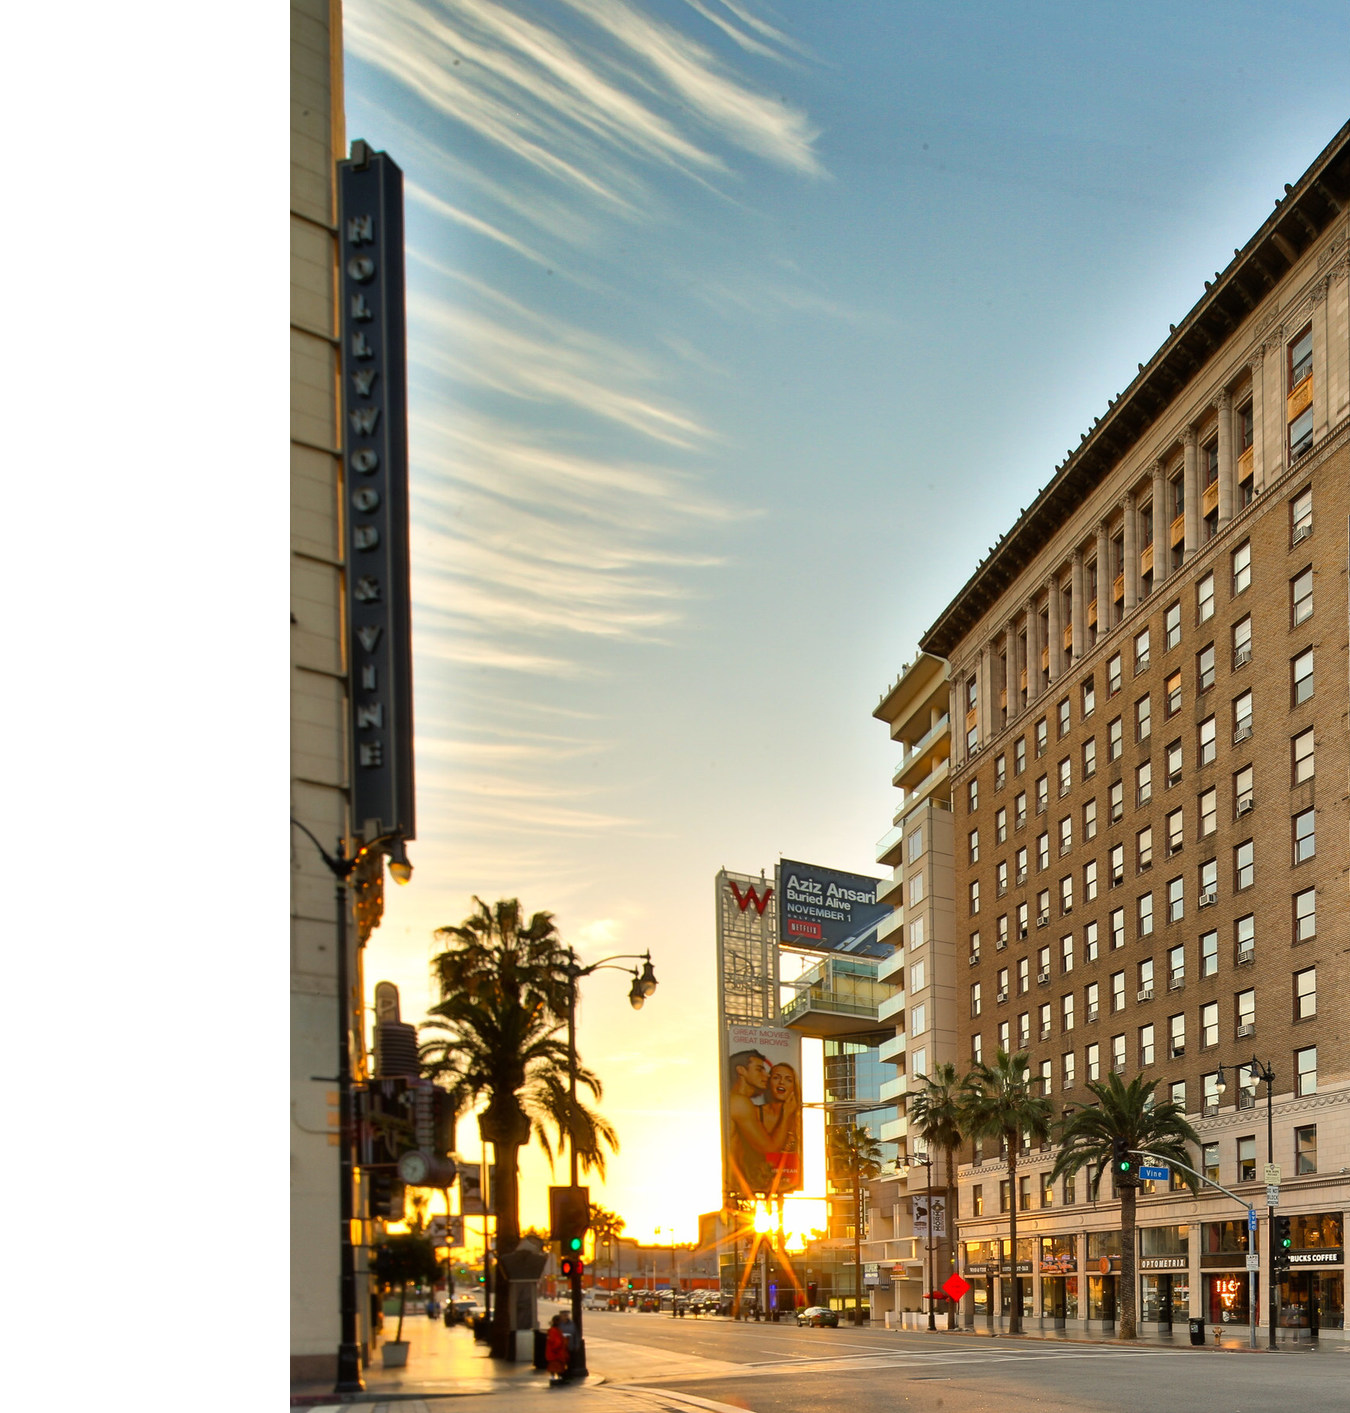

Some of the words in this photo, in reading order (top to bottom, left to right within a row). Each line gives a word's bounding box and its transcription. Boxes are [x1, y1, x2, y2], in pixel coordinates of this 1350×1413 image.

[347, 215, 380, 552] HOLLYWOOD
[353, 575, 382, 602] &
[354, 626, 385, 768] VINE
[728, 881, 774, 917] W
[786, 889, 823, 905] Buried
[825, 897, 851, 911] Alive
[787, 875, 822, 894] Aziz
[826, 883, 876, 905] Ansari
[787, 903, 845, 921] NOVEMBER
[846, 914, 852, 923] 1
[791, 923, 817, 934] NETFLIX
[733, 1028, 757, 1036] GREAT
[733, 1035, 757, 1043] GREAT
[1146, 1170, 1162, 1178] Vine
[1141, 1259, 1185, 1268] OPTOMETRIX
